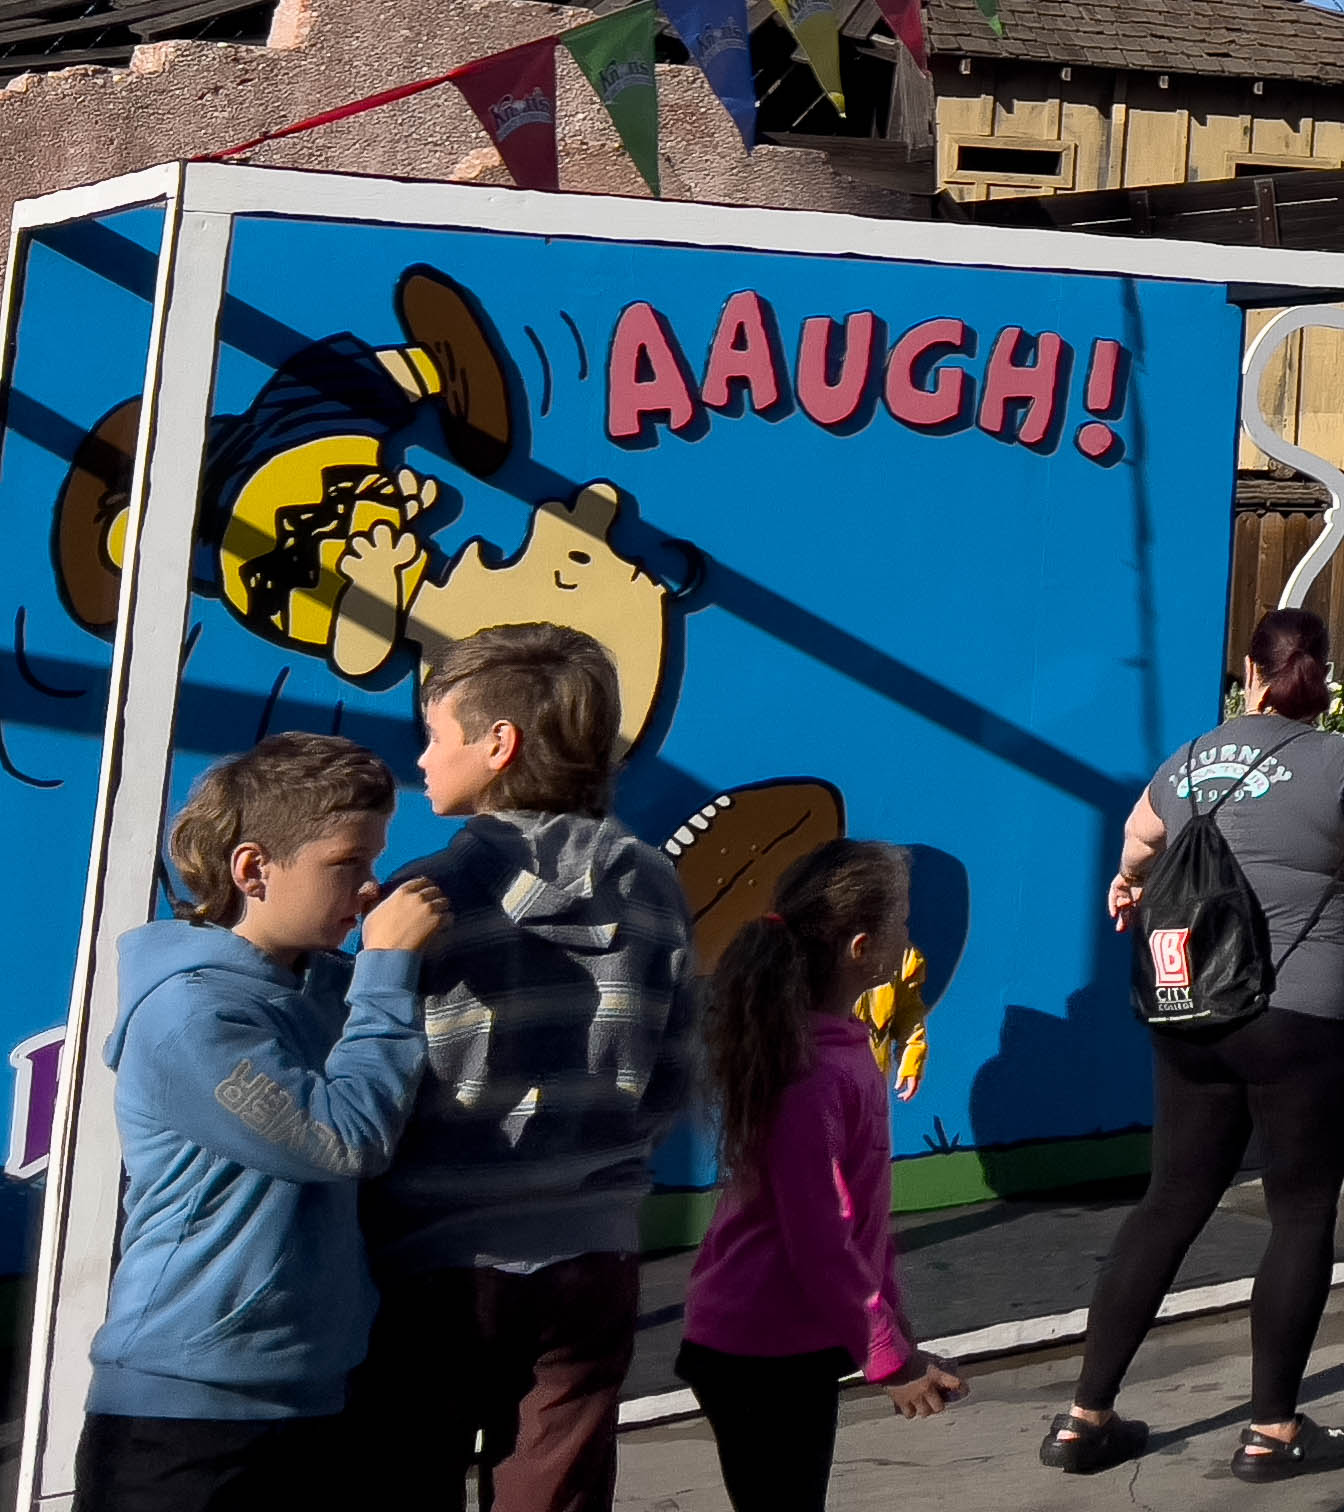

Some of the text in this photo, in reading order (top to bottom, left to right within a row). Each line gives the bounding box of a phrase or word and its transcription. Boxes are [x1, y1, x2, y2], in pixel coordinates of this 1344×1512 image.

[698, 26, 743, 52] Kntt's
[600, 59, 648, 90] Kntt's
[491, 96, 549, 130] Kntt's
[606, 288, 1128, 468] AAUGH!
[1195, 789, 1246, 803] 199
[1156, 986, 1191, 1002] CITY
